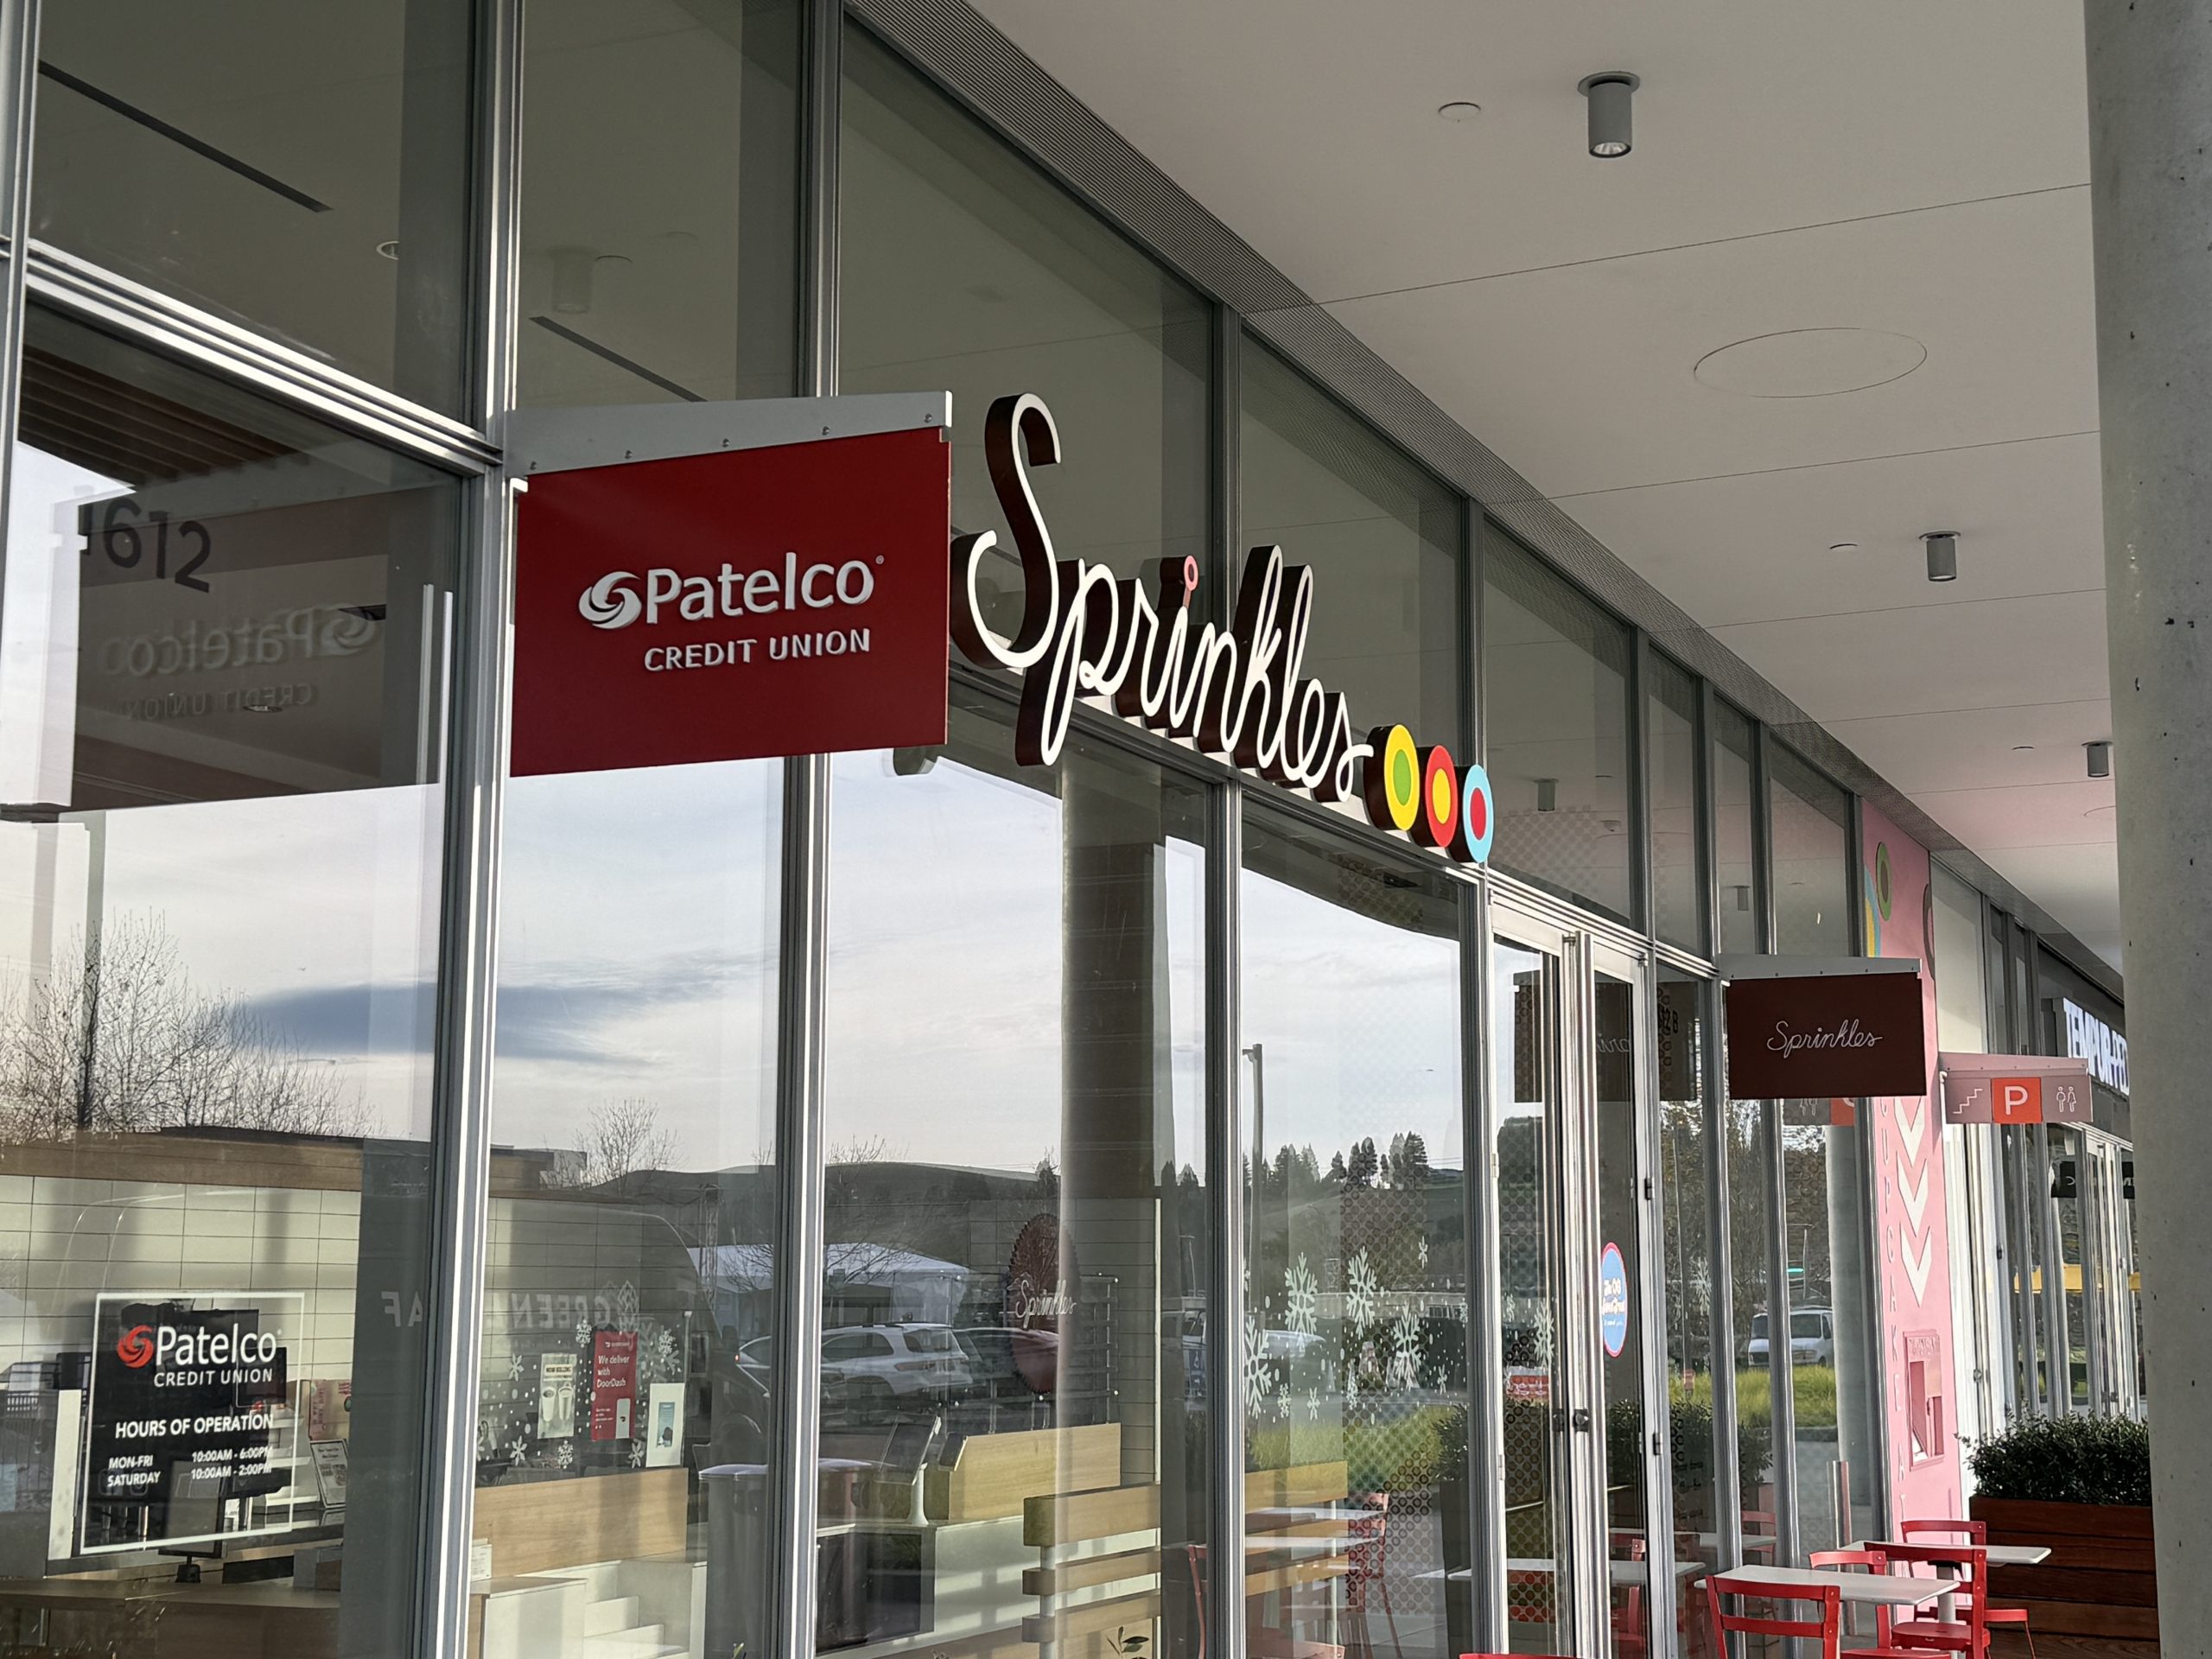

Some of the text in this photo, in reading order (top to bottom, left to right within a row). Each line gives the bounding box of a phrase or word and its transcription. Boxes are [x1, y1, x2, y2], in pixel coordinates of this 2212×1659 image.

[645, 551, 875, 625] Patelco
[965, 392, 1375, 803] Sprinkles
[644, 627, 871, 672] CREDIT UNION
[1766, 1019, 1884, 1058] Sprinkles
[2004, 1085, 2029, 1116] P
[156, 1322, 277, 1367] Patelco
[154, 1368, 273, 1388] CREDIT UNION
[115, 1413, 274, 1440] HOURS OF OPERATION
[108, 1454, 154, 1469] MON-FRI
[191, 1448, 232, 1463] 10:00AM
[107, 1471, 162, 1487] SATURDAY
[190, 1466, 232, 1480] 10:00AM
